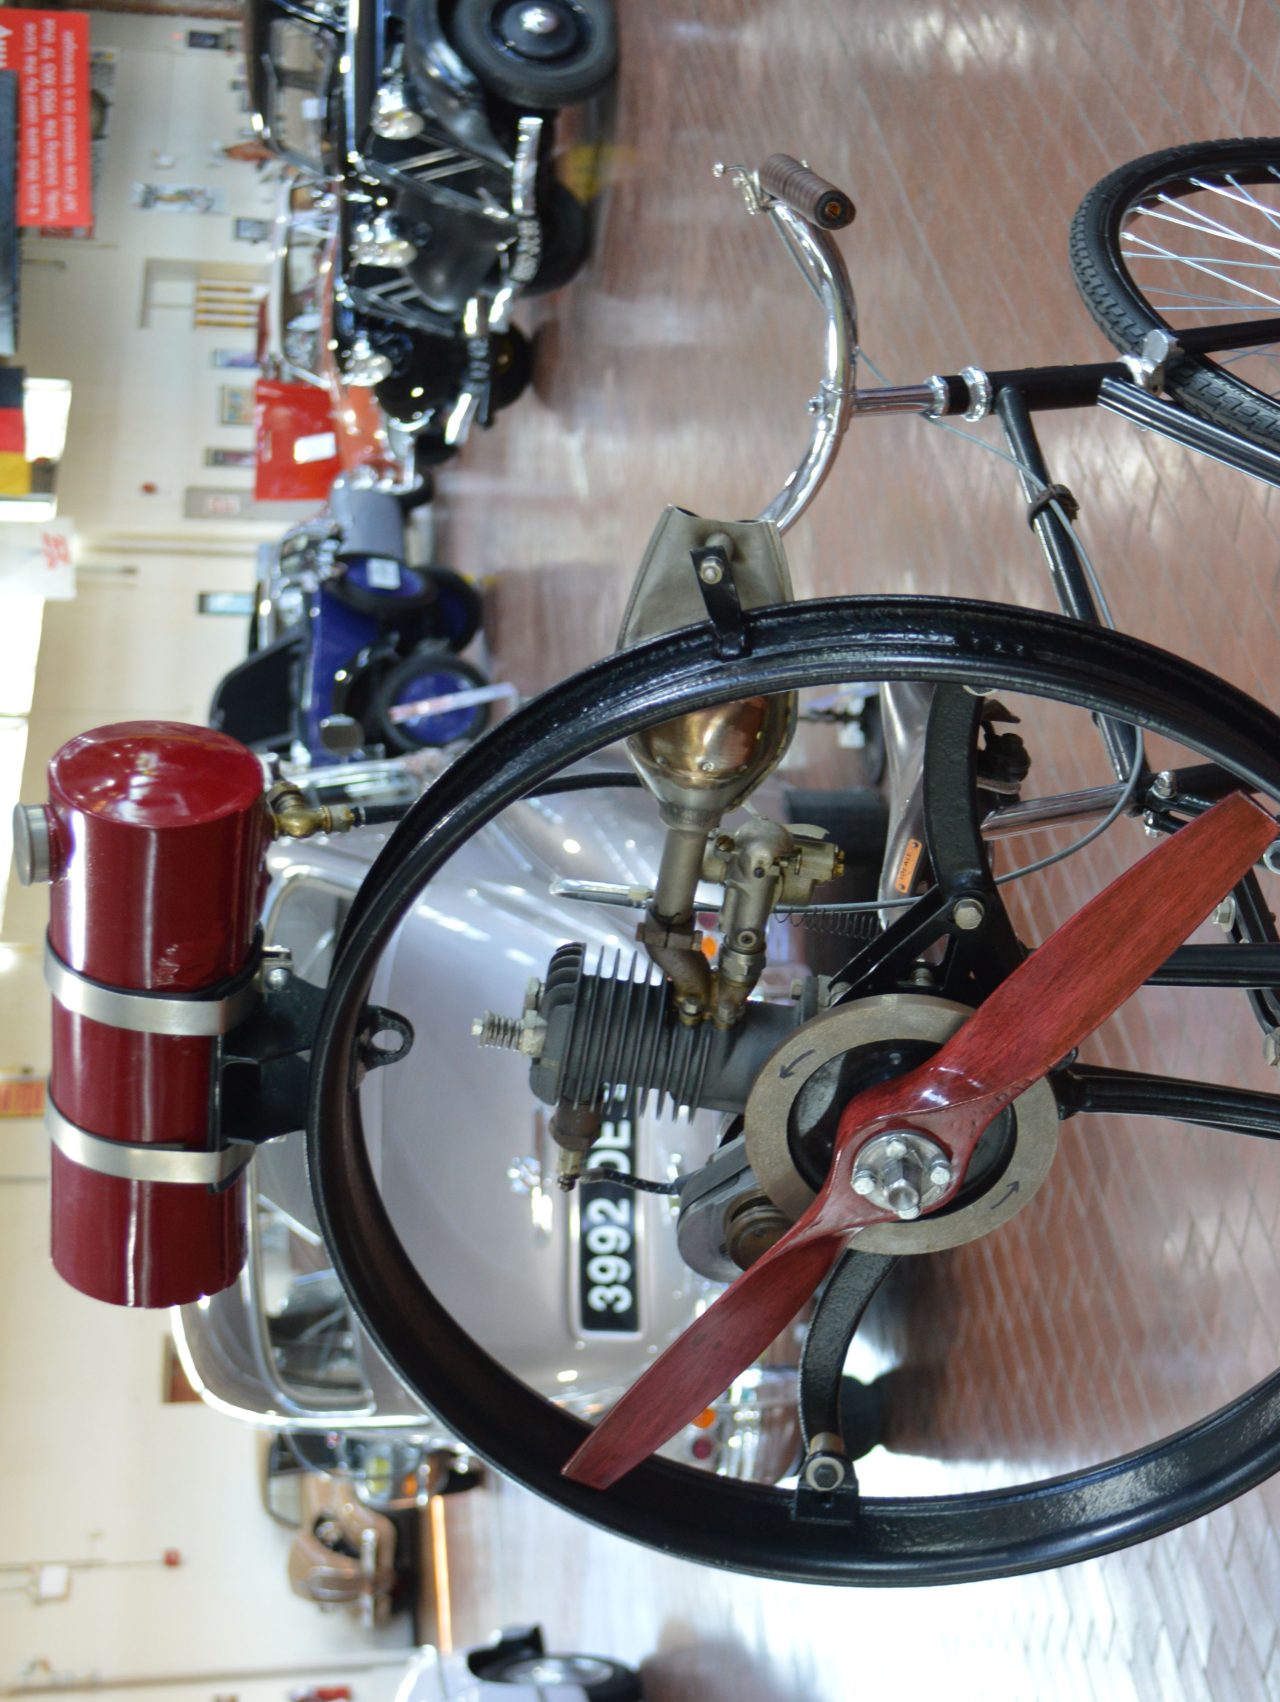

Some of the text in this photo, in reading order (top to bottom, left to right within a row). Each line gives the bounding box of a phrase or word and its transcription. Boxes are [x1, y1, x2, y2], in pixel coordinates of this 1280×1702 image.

[42, 18, 56, 43] that
[24, 55, 37, 74] the
[25, 76, 40, 94] by
[43, 118, 57, 137] the
[61, 115, 76, 161] restored
[26, 126, 39, 156] were
[25, 159, 39, 182] that
[587, 1198, 632, 1313] 3992
